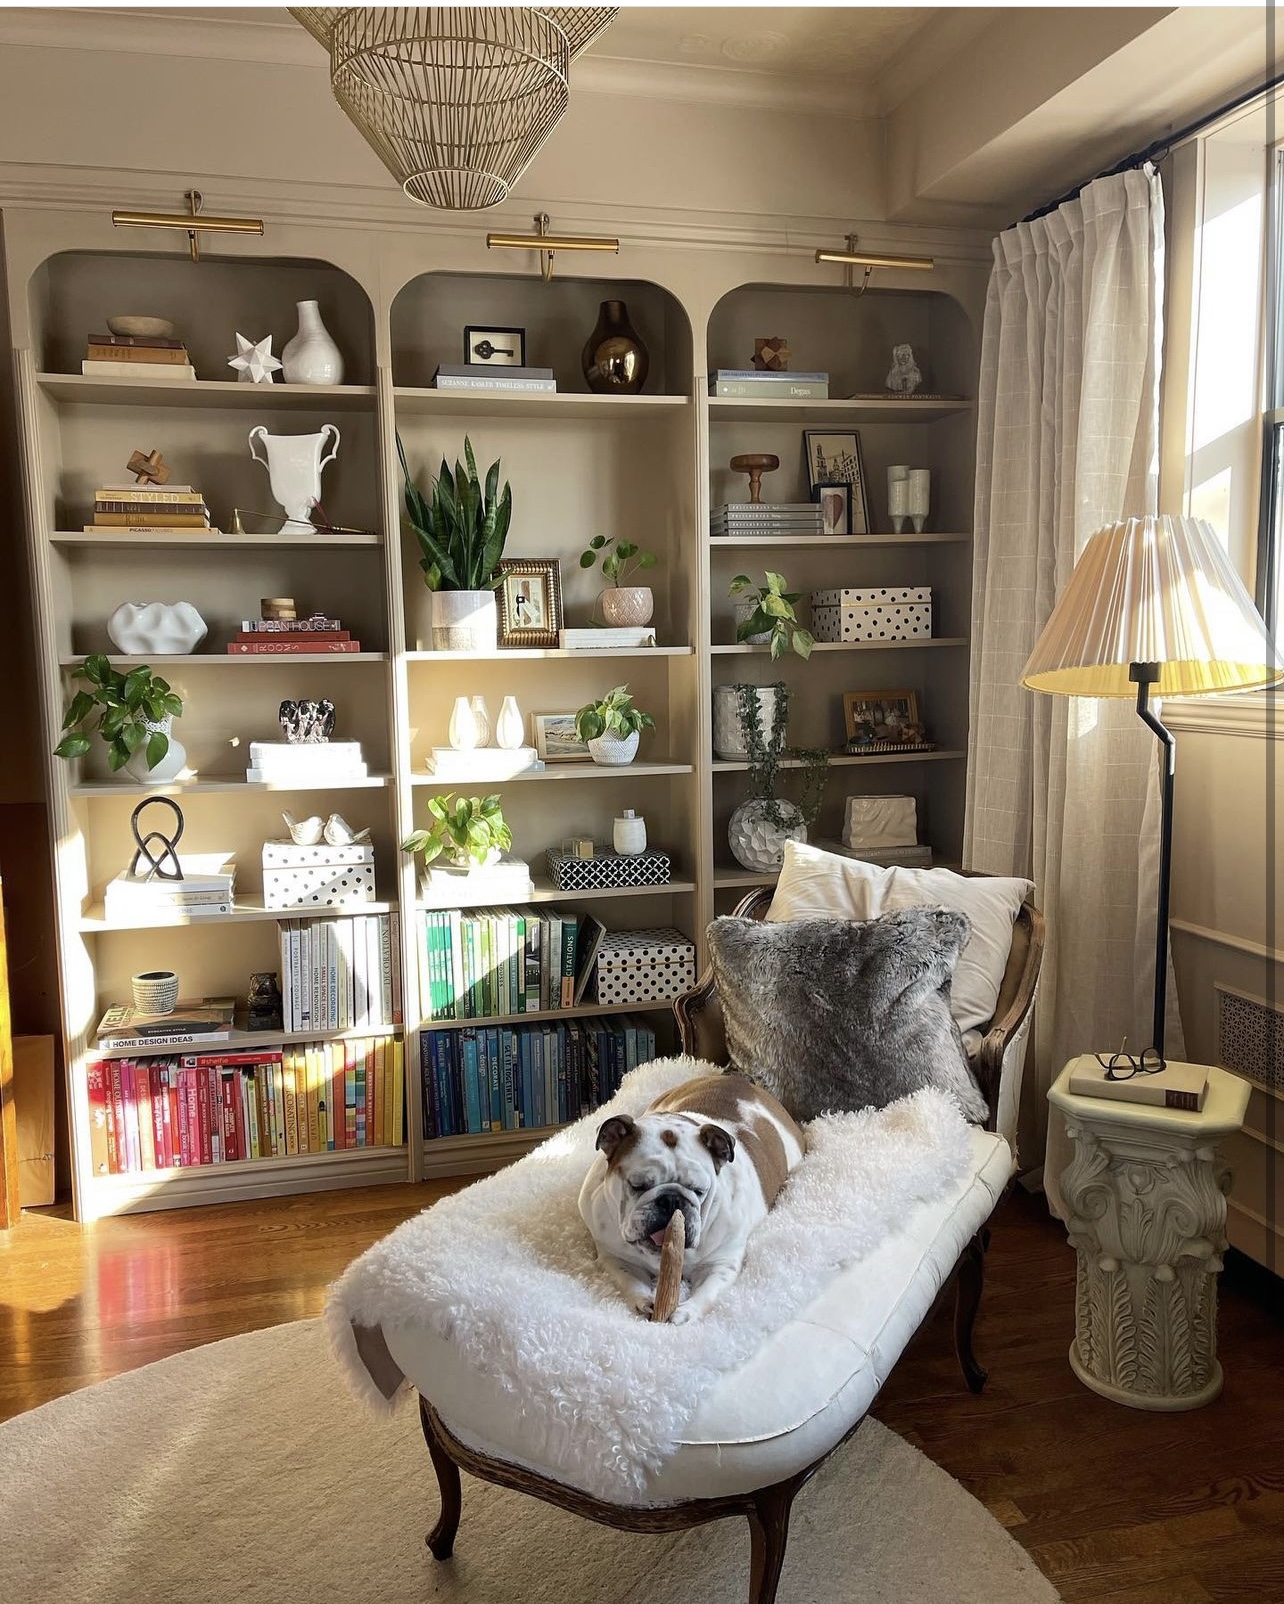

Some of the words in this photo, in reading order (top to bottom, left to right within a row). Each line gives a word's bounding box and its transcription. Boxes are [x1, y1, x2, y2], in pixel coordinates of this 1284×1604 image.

[471, 380, 494, 388] KASLER
[496, 381, 524, 389] TIMELESS
[526, 382, 544, 390] STYLE
[130, 492, 180, 502] STYLED
[291, 620, 331, 631] HOUSE
[259, 644, 300, 652] ROOMS
[382, 929, 391, 986] DECORATION
[565, 935, 574, 976] CITATIONS
[112, 1040, 137, 1048] HOME
[138, 1038, 168, 1046] DESIGN
[422, 1038, 430, 1066] JONATHAN
[437, 1039, 446, 1067] SINGER
[479, 1054, 487, 1077] design
[491, 1056, 499, 1091] DECORATE
[112, 1069, 121, 1091] HOME
[187, 1088, 197, 1118] Home
[286, 1087, 296, 1135] CORATING
[179, 1102, 187, 1134] decorating
